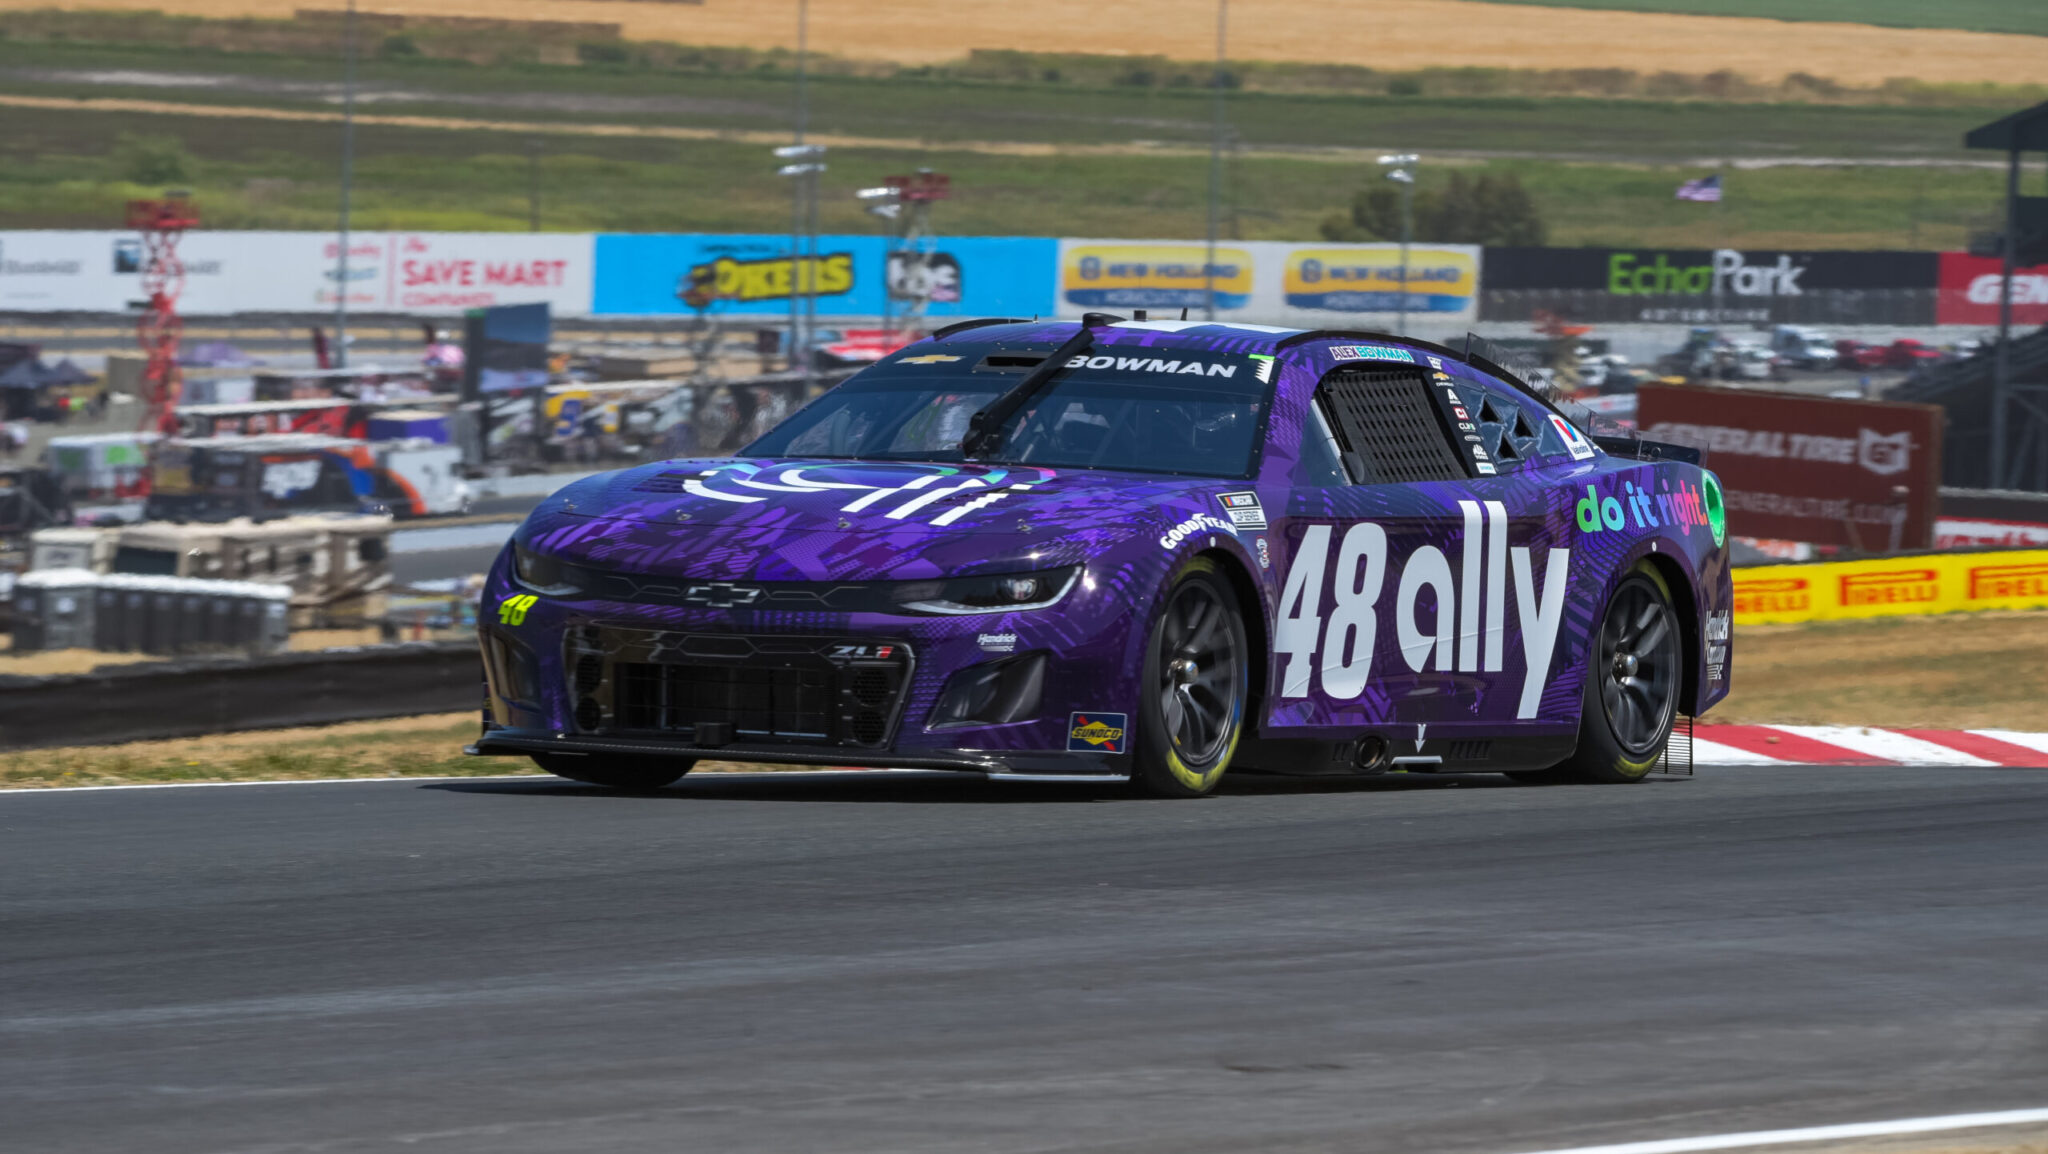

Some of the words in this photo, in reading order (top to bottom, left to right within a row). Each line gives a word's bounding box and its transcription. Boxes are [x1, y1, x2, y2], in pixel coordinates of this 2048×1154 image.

[402, 259, 476, 287] SAVE
[484, 259, 567, 287] MART
[1609, 249, 1806, 296] EchoPark
[1065, 354, 1238, 378] BOWMAN
[1330, 347, 1360, 359] ALEX
[1355, 346, 1414, 362] BOWMAN
[1788, 432, 1860, 464] TIRE
[1576, 484, 1626, 533] do
[1625, 480, 1660, 529] it
[1159, 512, 1239, 550] GOODYEAR
[1838, 569, 1939, 607] PIRELLI
[1273, 521, 1388, 700] 48
[1396, 500, 1570, 720] ally
[1073, 728, 1121, 738] SUNOCO
